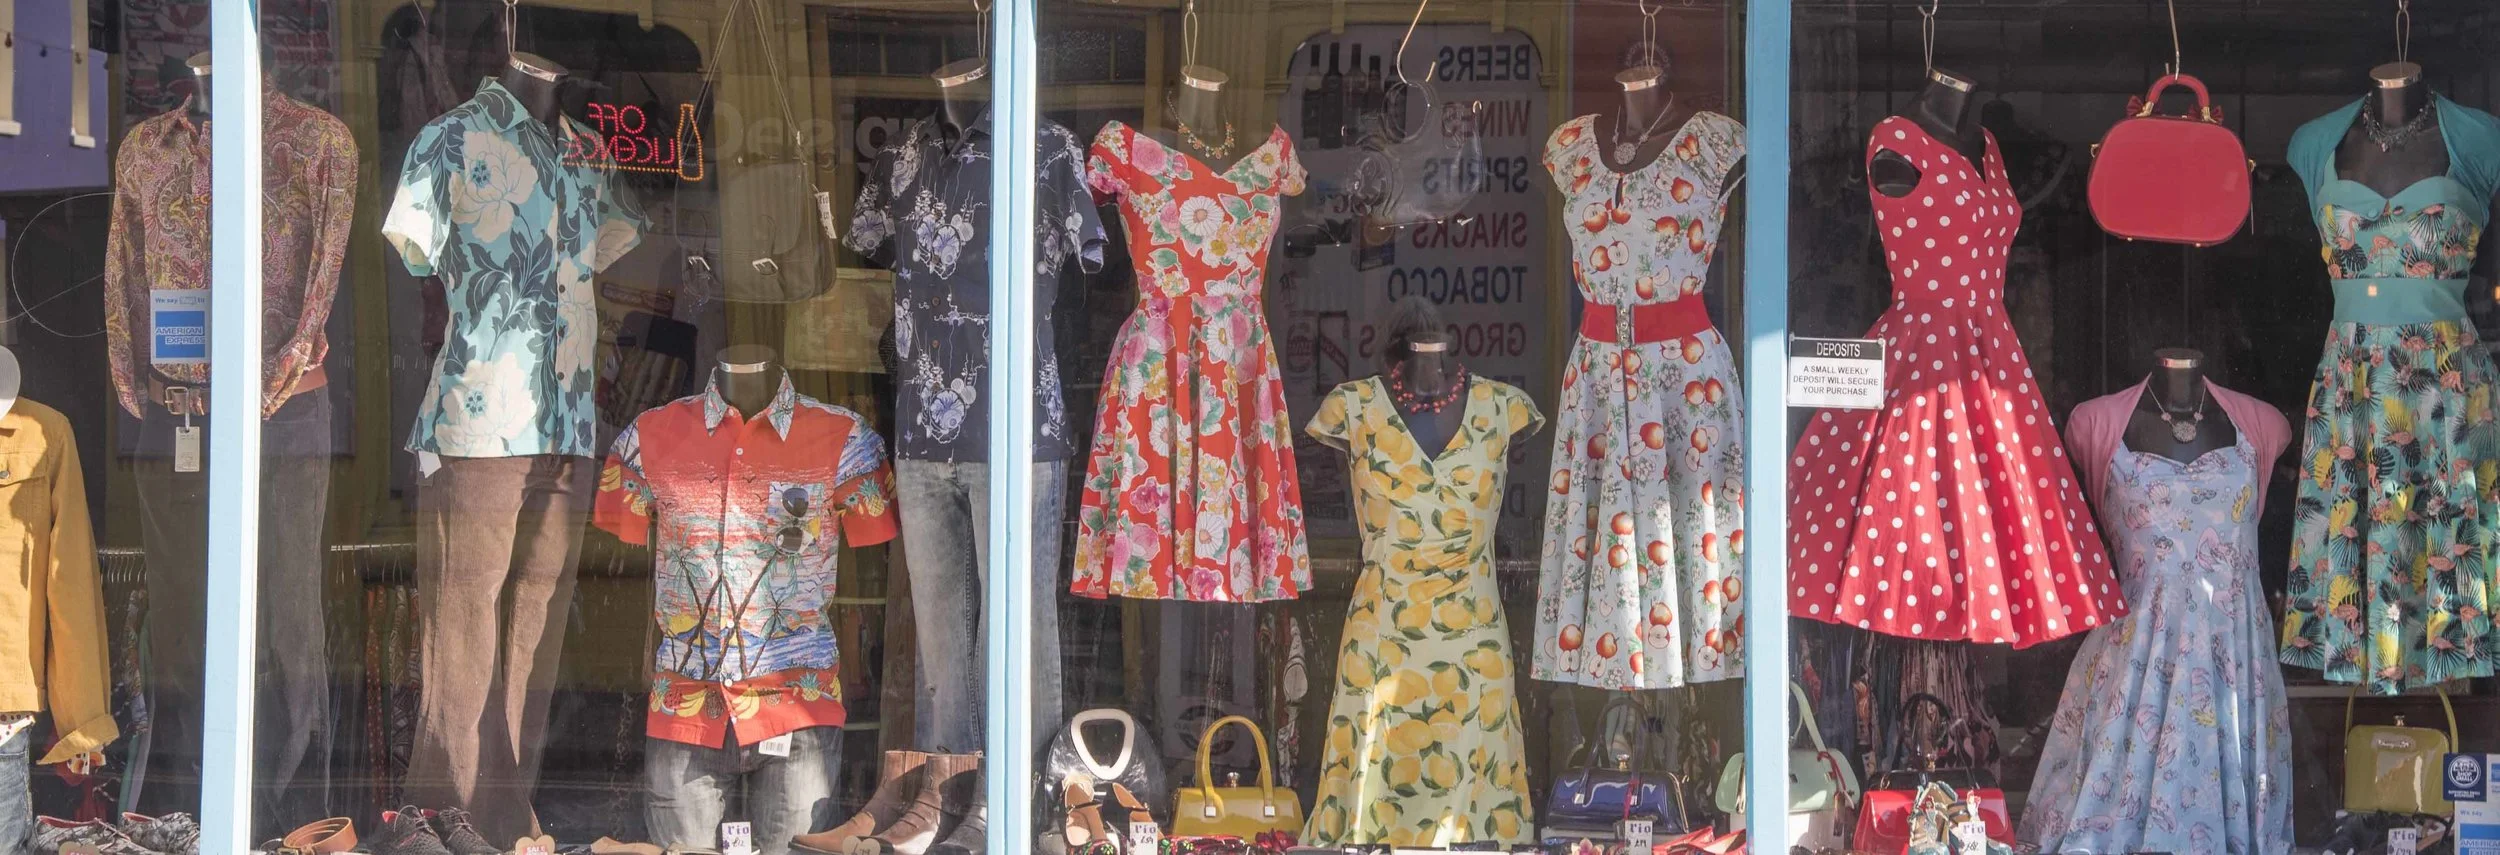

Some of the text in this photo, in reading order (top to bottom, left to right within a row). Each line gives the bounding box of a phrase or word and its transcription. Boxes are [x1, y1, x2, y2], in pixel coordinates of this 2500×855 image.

[154, 326, 204, 336] AMERICAN
[165, 336, 206, 345] EXPRESS
[1816, 342, 1861, 357] DEPOSITS
[1803, 365, 1869, 375] A SMALL WEEKLY
[1793, 375, 1879, 386] DEPOSIT WILL SECURE
[1803, 386, 1868, 396] YOUR PURCHASE
[727, 824, 750, 835] rio
[1135, 824, 1157, 834] rio
[1630, 823, 1652, 833] rio
[1962, 823, 1985, 834] rio
[2392, 830, 2415, 840] rio
